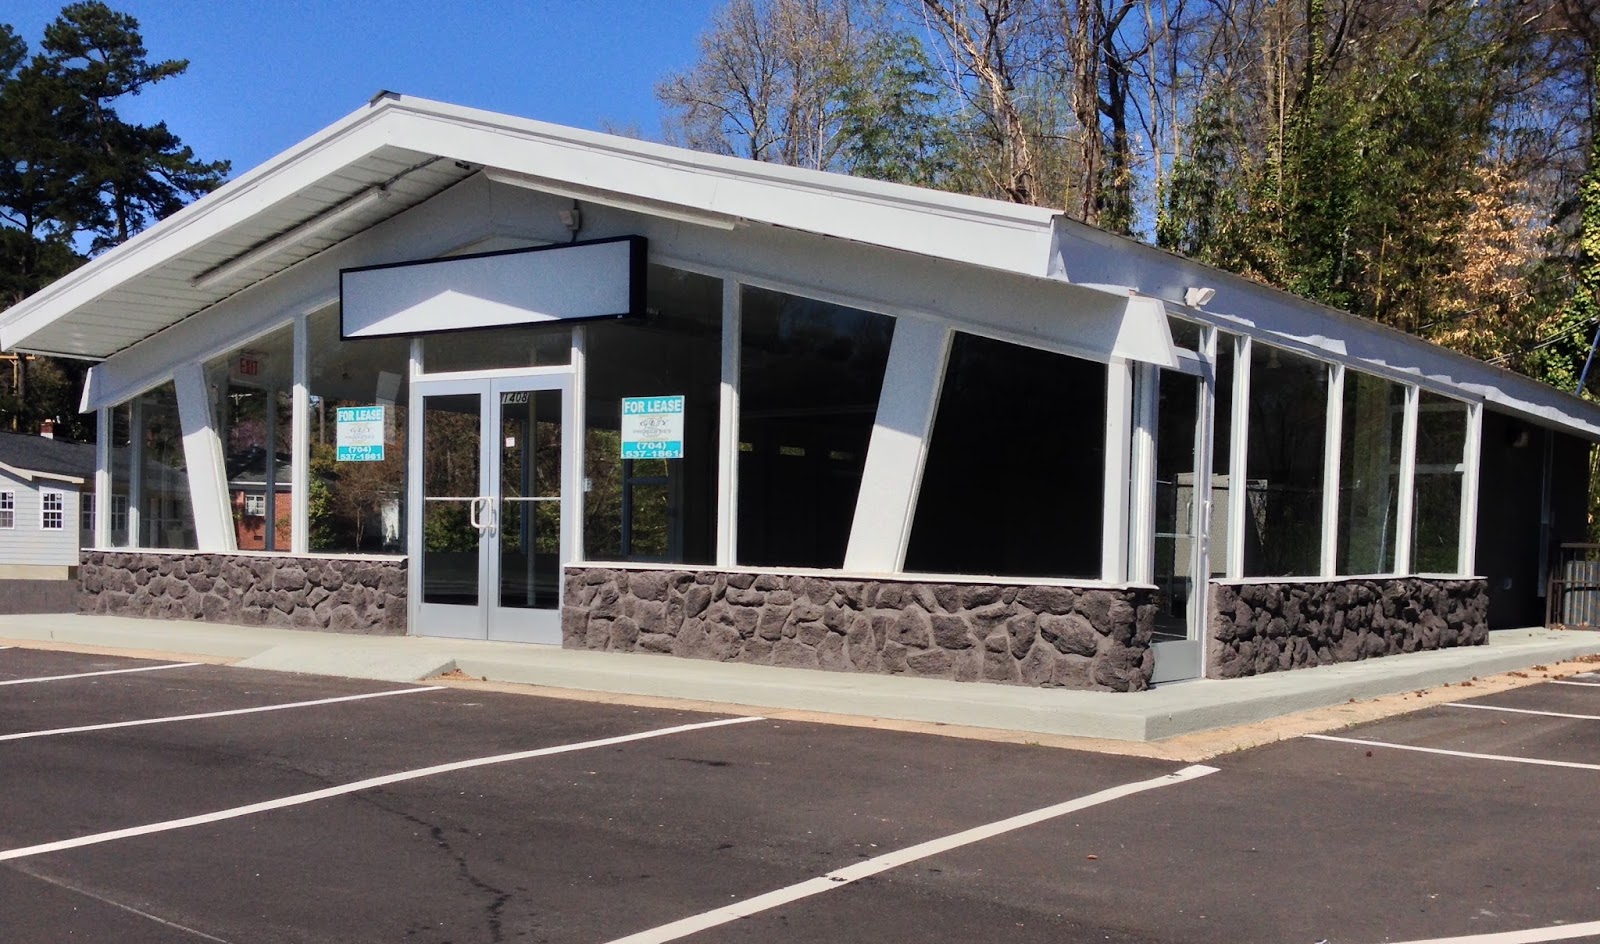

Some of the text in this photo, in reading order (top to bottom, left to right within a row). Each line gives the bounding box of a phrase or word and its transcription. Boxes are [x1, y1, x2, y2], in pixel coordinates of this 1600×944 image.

[240, 357, 258, 376] EXIT
[503, 392, 528, 403] 1408
[624, 399, 682, 413] FOR LEASE
[338, 409, 381, 422] FOR LEASE
[636, 442, 667, 450] (704)
[625, 450, 680, 458] 537-1861
